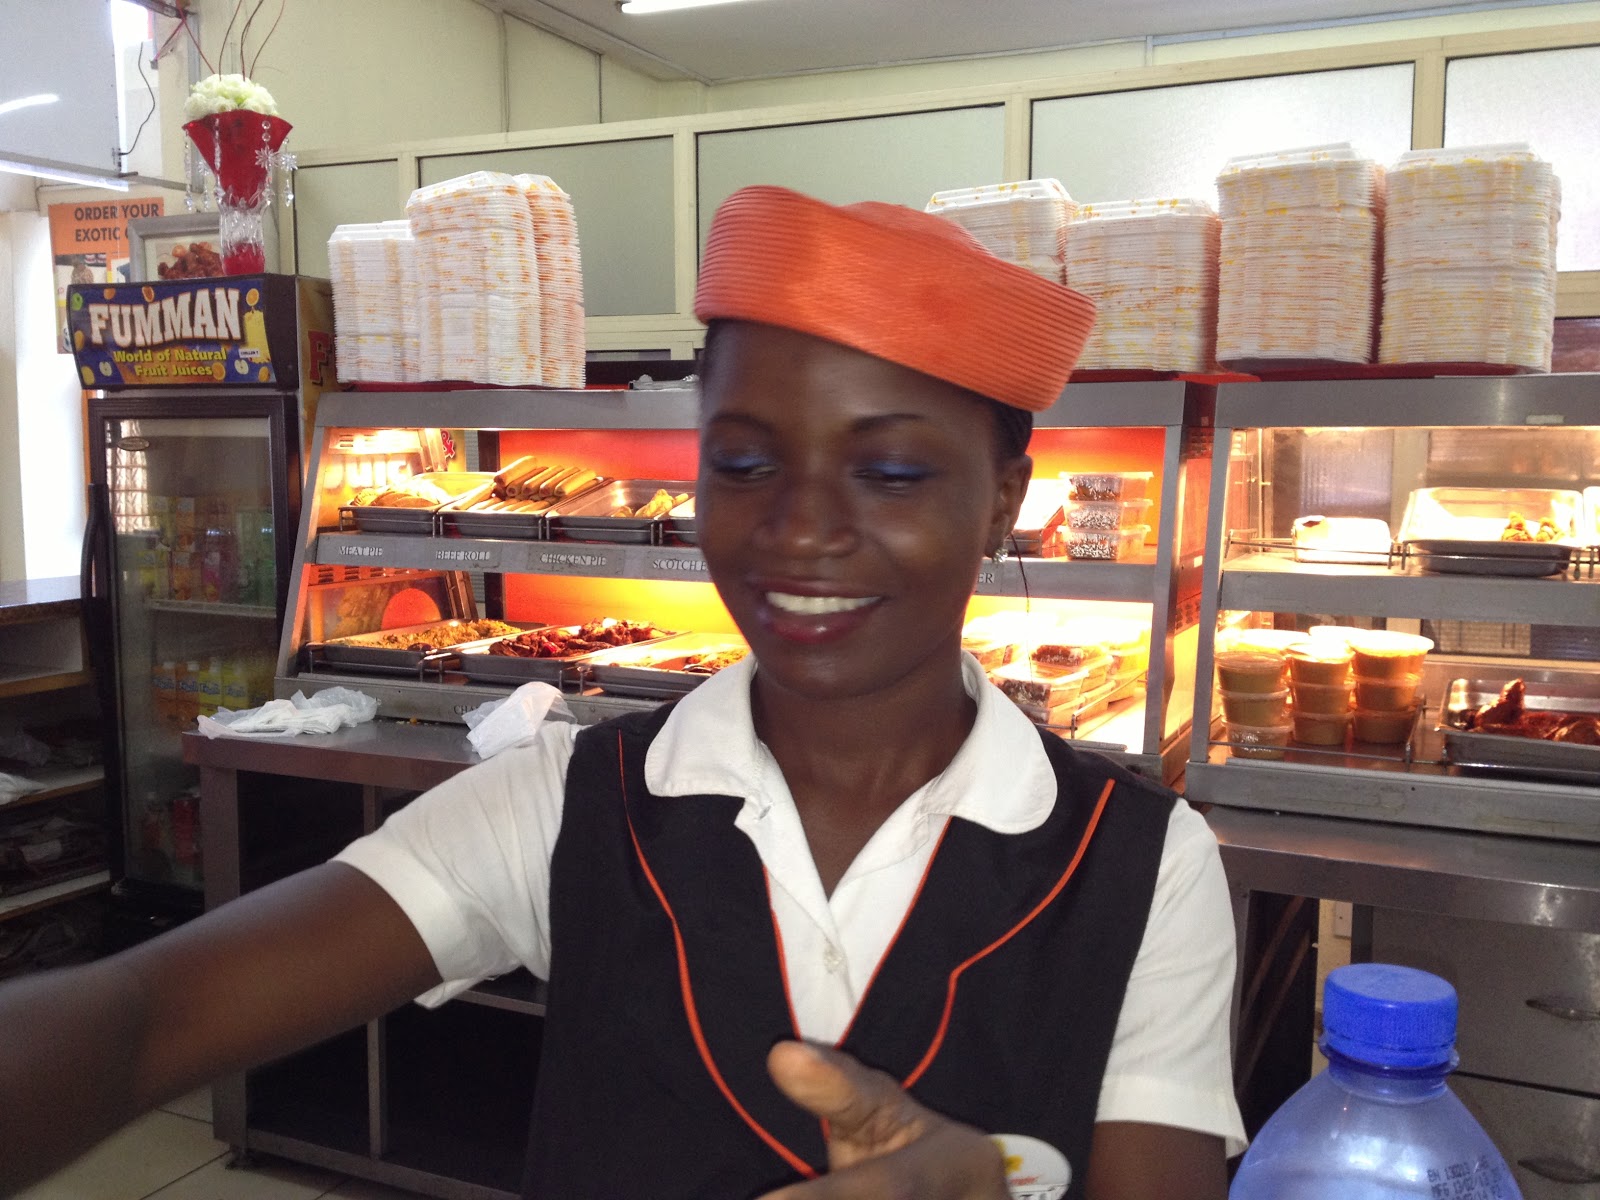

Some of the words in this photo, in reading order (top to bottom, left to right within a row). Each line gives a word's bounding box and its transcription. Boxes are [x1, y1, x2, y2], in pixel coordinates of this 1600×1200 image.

[74, 206, 118, 221] ORDER
[121, 204, 159, 218] YOUR
[75, 227, 120, 242] EXOTIC
[88, 287, 242, 348] FUMMAN
[113, 349, 153, 362] World
[156, 348, 171, 361] of
[174, 347, 227, 361] Natural
[134, 365, 168, 377] Fruit
[172, 364, 213, 376] Juices
[338, 546, 365, 556] MEAT
[367, 547, 383, 556] PIE
[435, 550, 461, 560] BEEF
[463, 550, 490, 561] ROLL
[539, 553, 587, 564] CHICKEN
[589, 555, 607, 566] PIE
[653, 559, 697, 571] SCOTCH
[977, 572, 994, 584] ER
